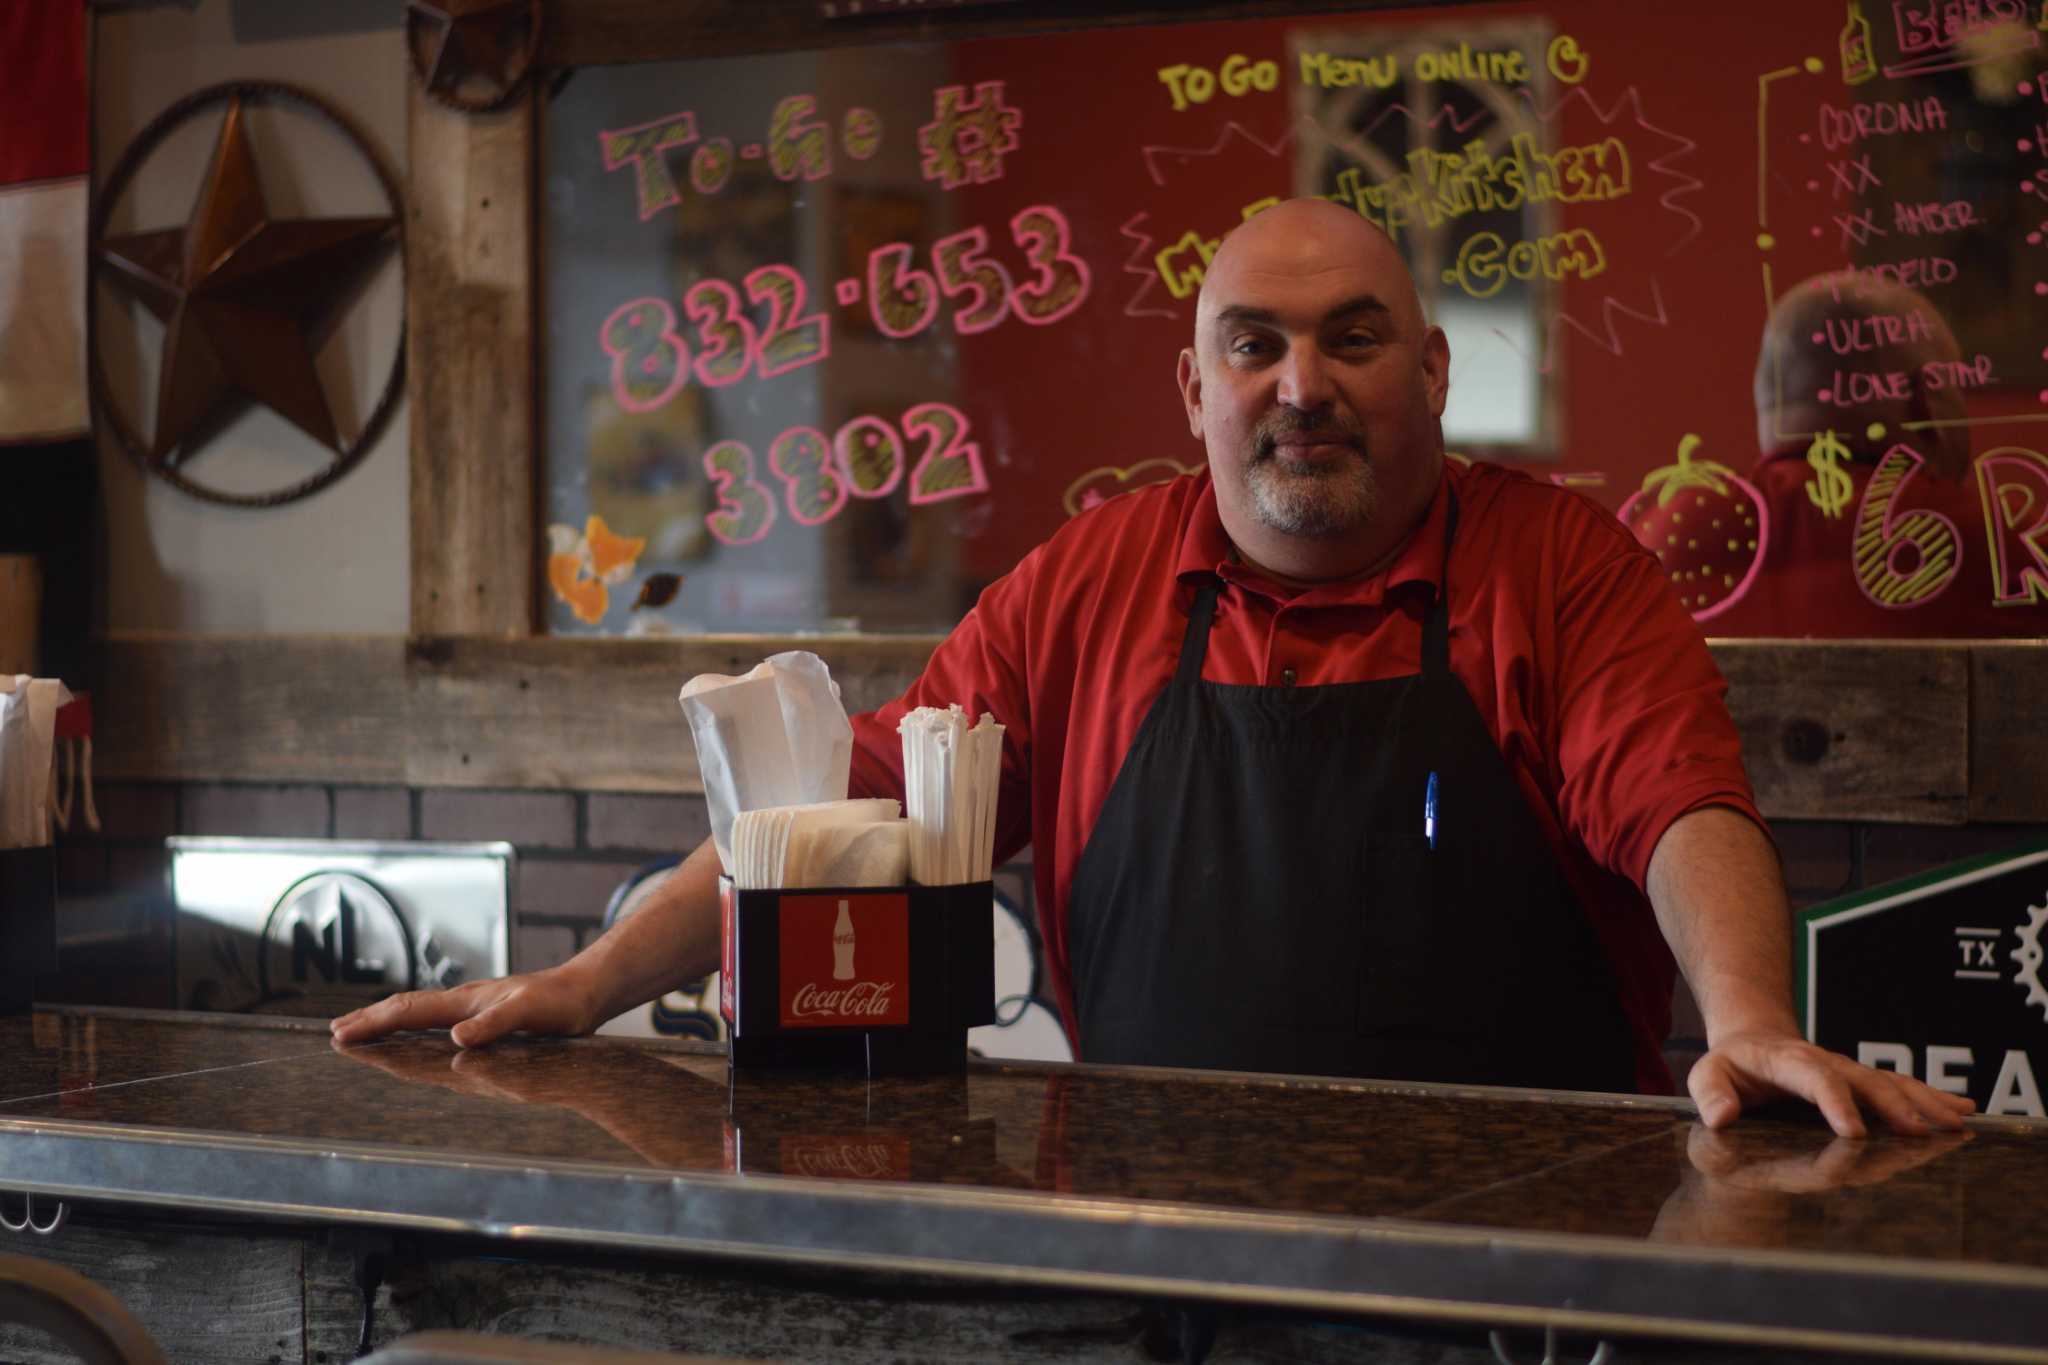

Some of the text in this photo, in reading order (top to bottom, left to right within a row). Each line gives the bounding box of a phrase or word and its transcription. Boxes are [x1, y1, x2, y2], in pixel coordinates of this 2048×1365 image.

[917, 80, 1022, 190] #
[1819, 96, 1947, 151] CORONA
[1826, 154, 1882, 200] XX
[1832, 207, 1888, 252] XX
[1824, 309, 1935, 356] ULTRA
[1832, 353, 2000, 408] LONE STAR
[703, 402, 990, 546] 3802
[1957, 939, 1996, 967] TX
[791, 981, 896, 1016] Coca-Cola
